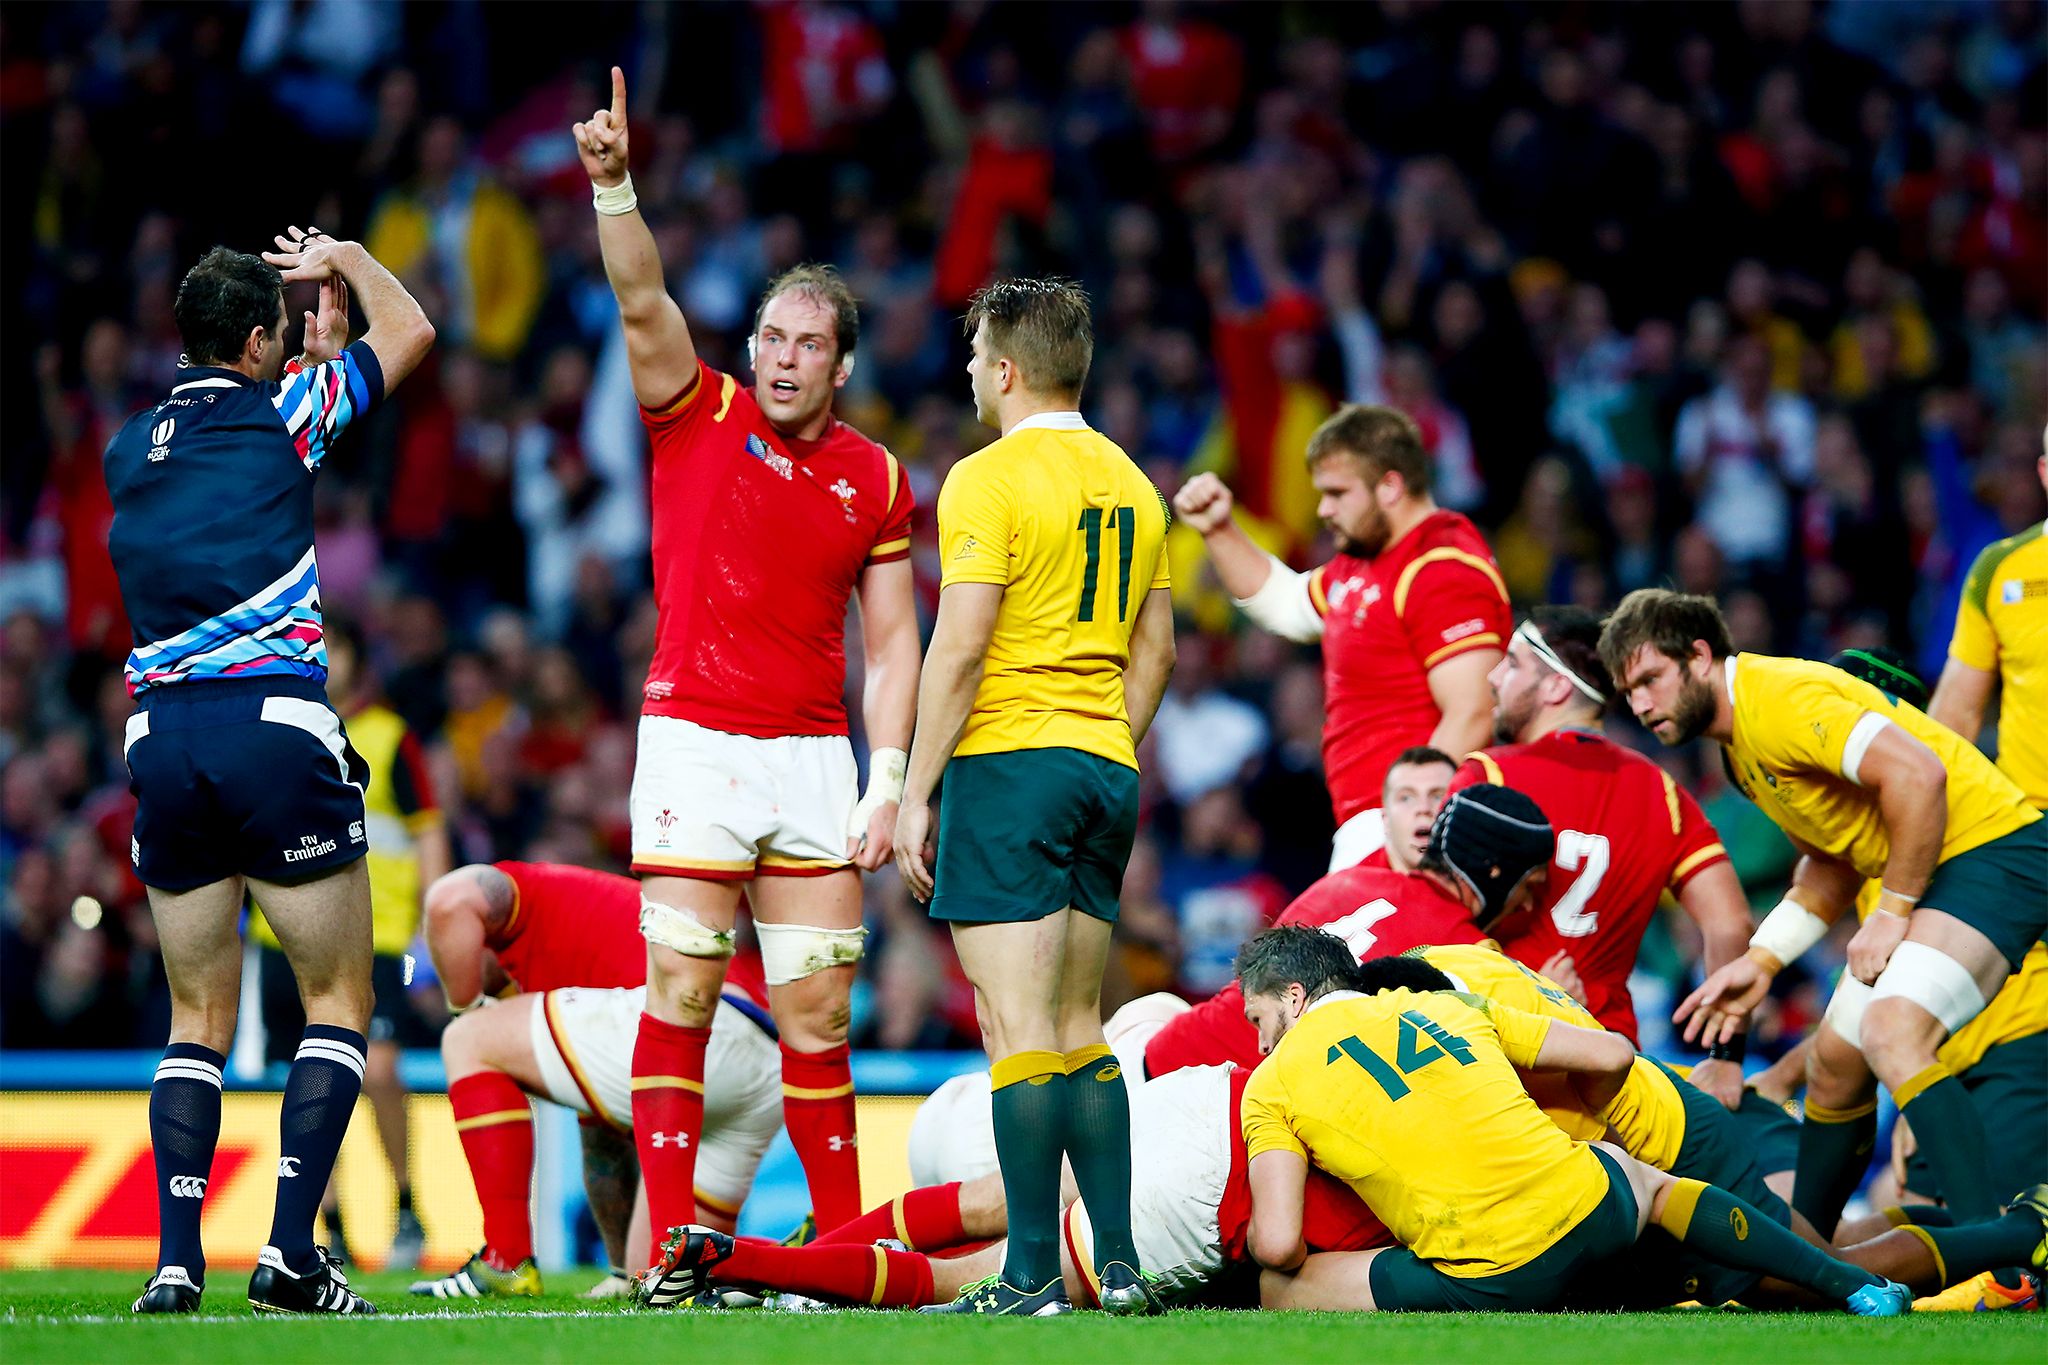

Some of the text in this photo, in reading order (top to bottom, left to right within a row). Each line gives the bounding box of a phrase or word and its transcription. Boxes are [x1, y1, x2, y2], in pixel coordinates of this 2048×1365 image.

[147, 448, 171, 460] RUGBY
[1077, 507, 1135, 622] 11
[283, 839, 337, 862] Emirates
[300, 834, 318, 846] Fly
[1550, 829, 1610, 937] 2
[1327, 1009, 1478, 1102] 14
